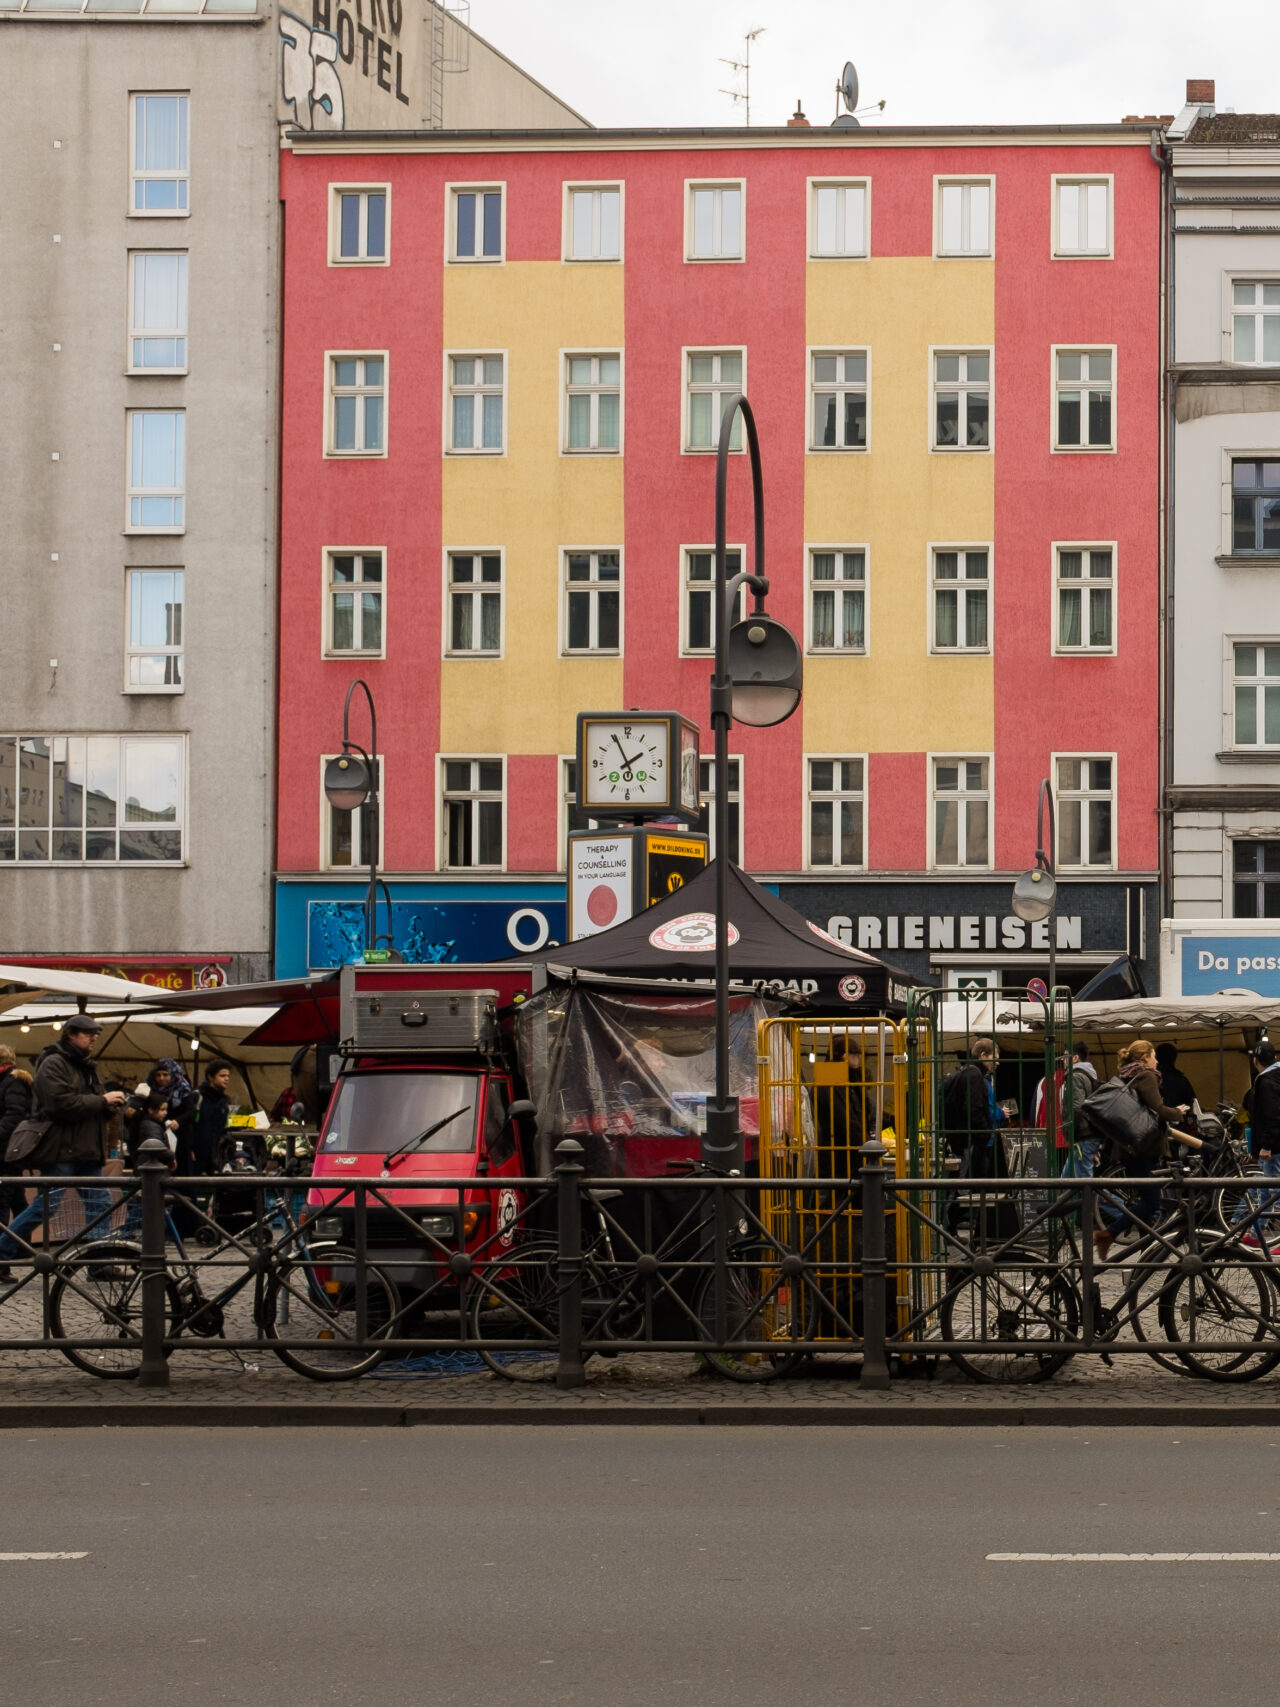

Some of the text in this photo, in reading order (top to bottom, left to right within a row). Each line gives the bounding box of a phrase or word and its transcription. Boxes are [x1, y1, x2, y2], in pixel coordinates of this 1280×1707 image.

[313, 0, 409, 106] HOTEL
[624, 727, 632, 735] 12
[593, 760, 598, 768] 9
[657, 759, 663, 768] 3
[624, 792, 631, 800] 6
[587, 844, 619, 853] THERAPY
[578, 860, 627, 870] COUNSELLING
[827, 915, 1081, 949] GRIENEISEN
[1198, 951, 1229, 970] Da
[140, 973, 183, 989] Cafe
